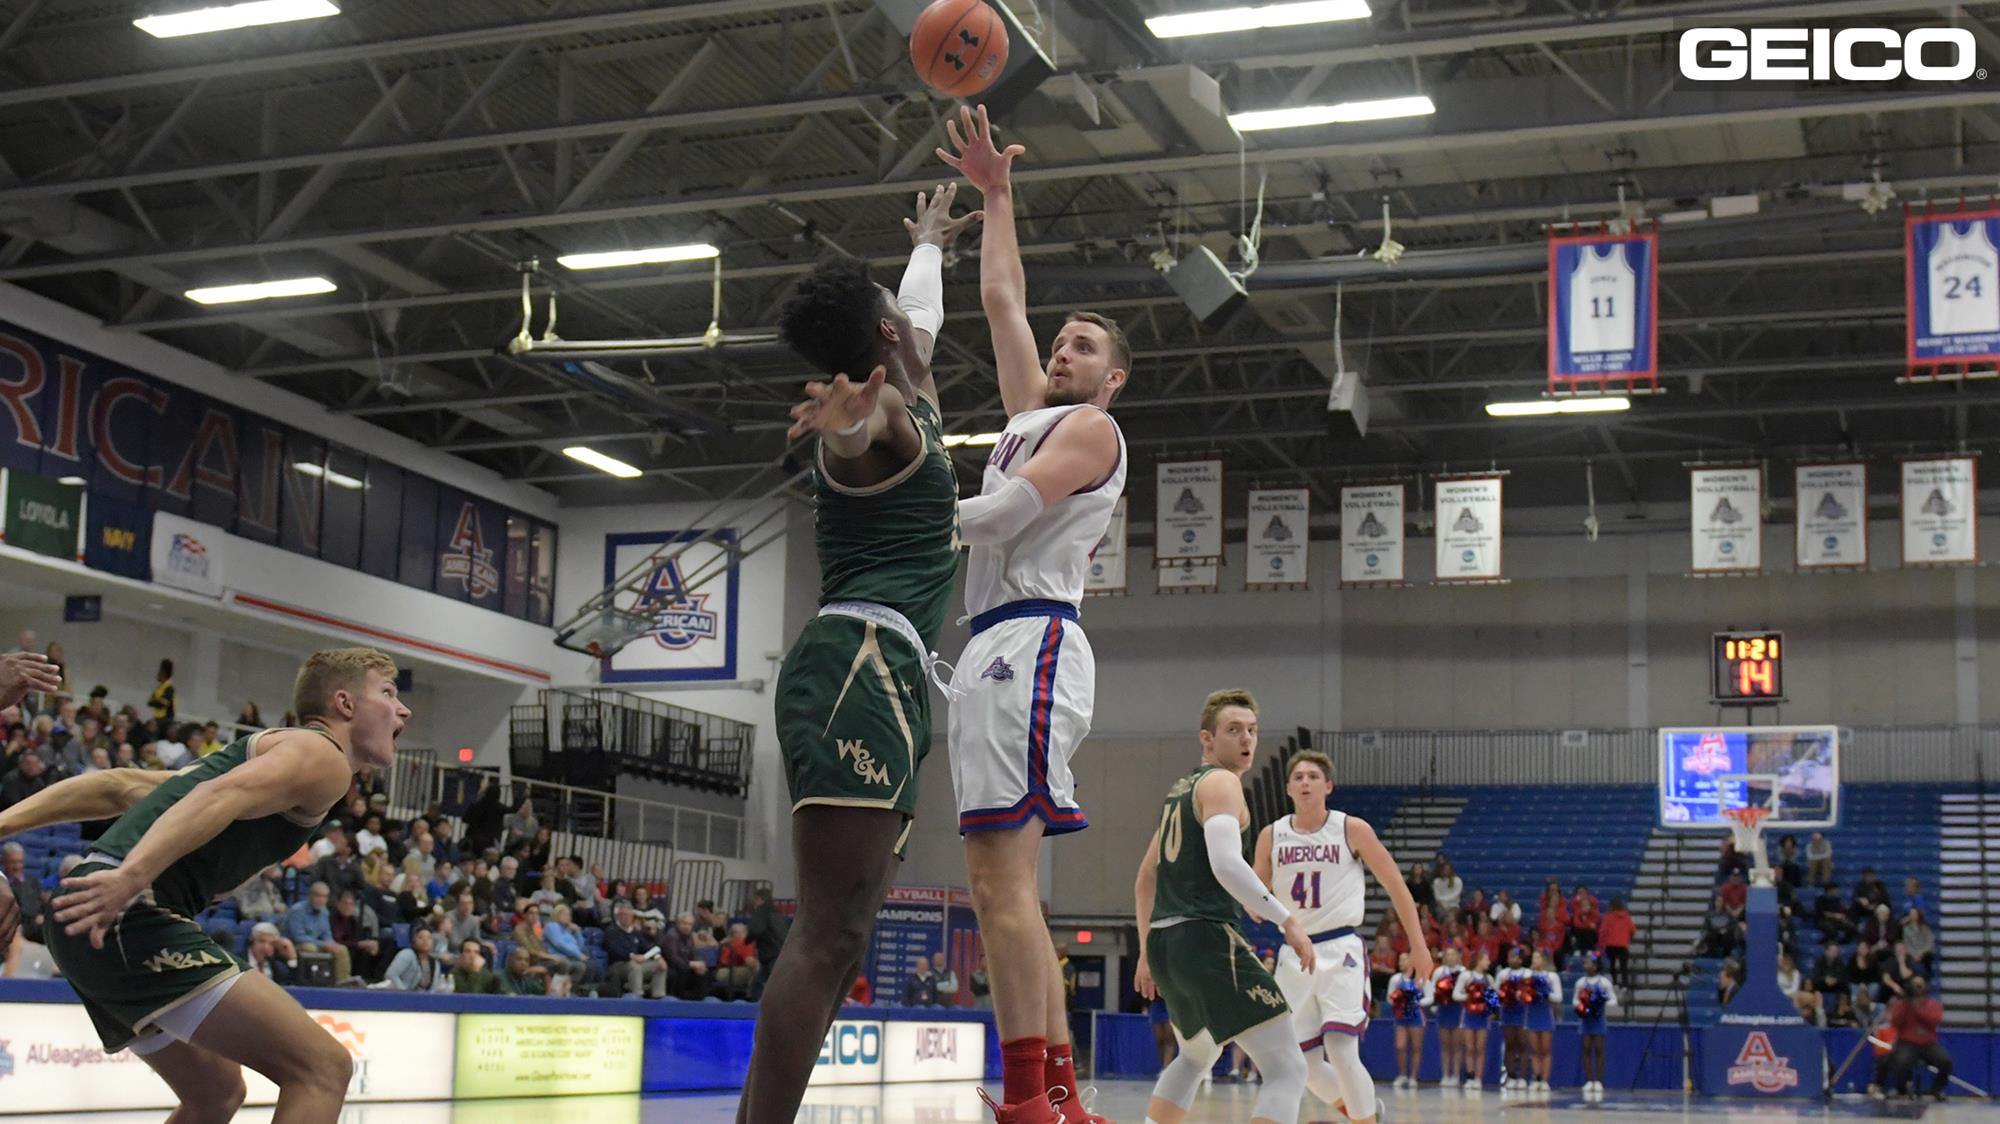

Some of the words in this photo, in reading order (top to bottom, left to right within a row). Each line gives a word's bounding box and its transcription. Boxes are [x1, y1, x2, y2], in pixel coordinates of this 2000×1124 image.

[1943, 276, 1981, 299] 24
[1591, 296, 1615, 318] 11
[1161, 474, 1216, 484] VOLLEYBALL
[1168, 465, 1209, 474] WOMEN'S
[1257, 495, 1298, 503] WOMEN'S
[1440, 496, 1496, 504] VOLLEYBALL
[1696, 485, 1757, 493] VOLLEYBALL
[19, 498, 70, 530] LOYOLA
[1251, 503, 1305, 511] VOLLEYBALL
[1344, 501, 1399, 510] VOLLEYBALL
[102, 526, 137, 553] NAVY
[1725, 638, 1779, 661] 11:21
[1738, 660, 1773, 695] 14
[836, 738, 892, 786] W&M
[1277, 844, 1340, 868] AMERICAN
[1290, 871, 1322, 909] 41
[1246, 984, 1284, 1008] W&M
